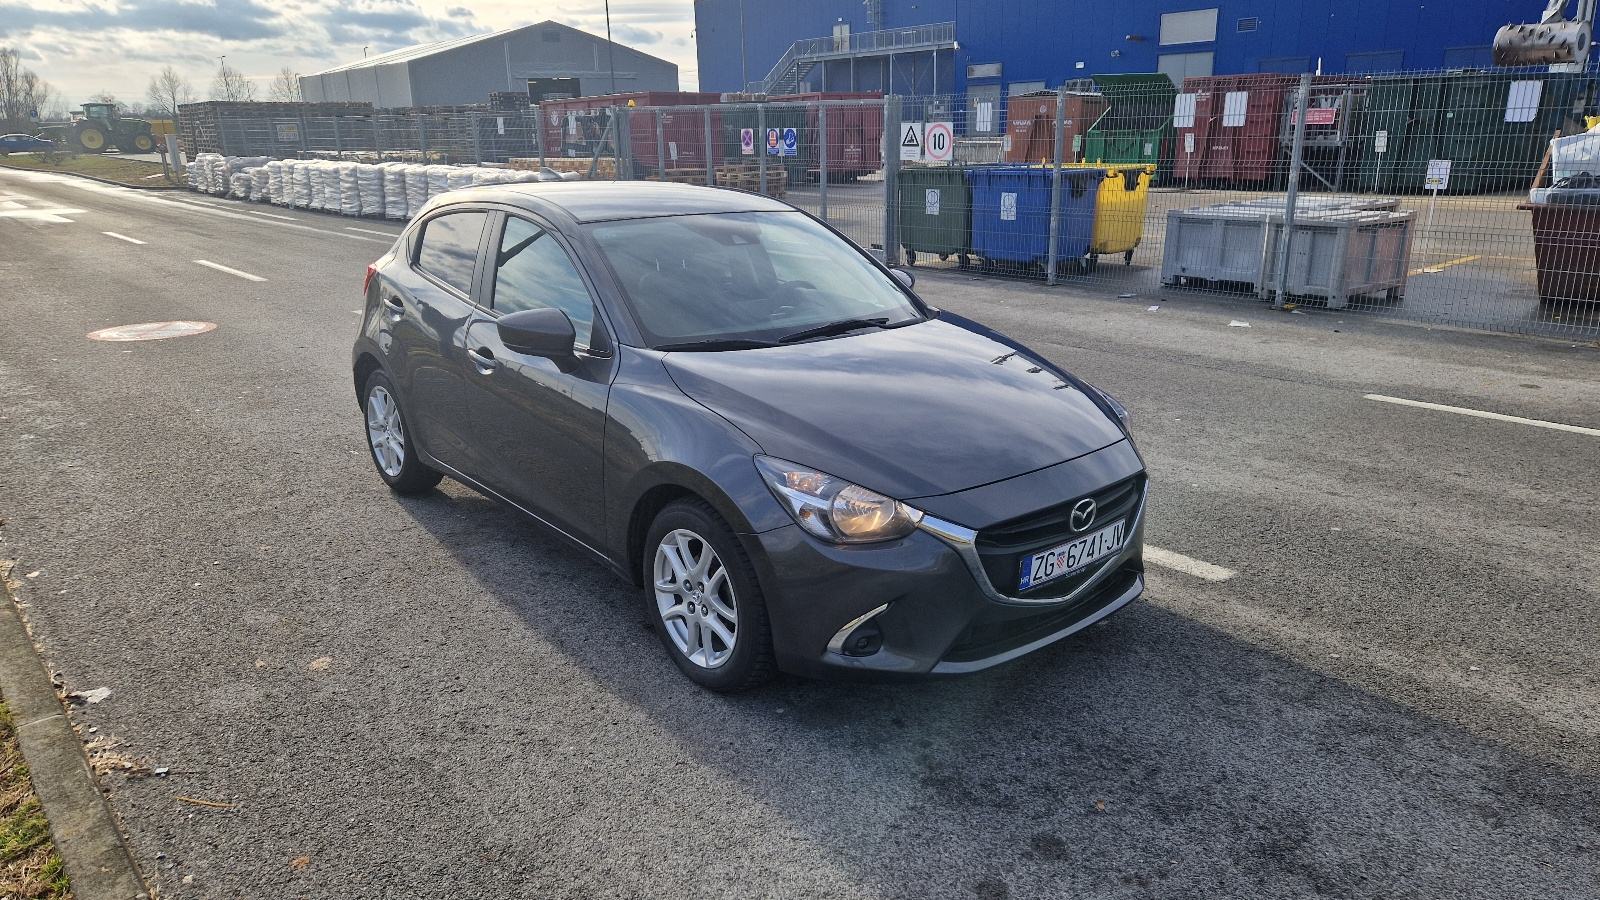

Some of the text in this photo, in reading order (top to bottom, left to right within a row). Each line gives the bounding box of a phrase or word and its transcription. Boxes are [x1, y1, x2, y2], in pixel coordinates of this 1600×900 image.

[933, 133, 945, 150] 10
[1033, 551, 1056, 581] ZG
[1020, 575, 1029, 585] HR
